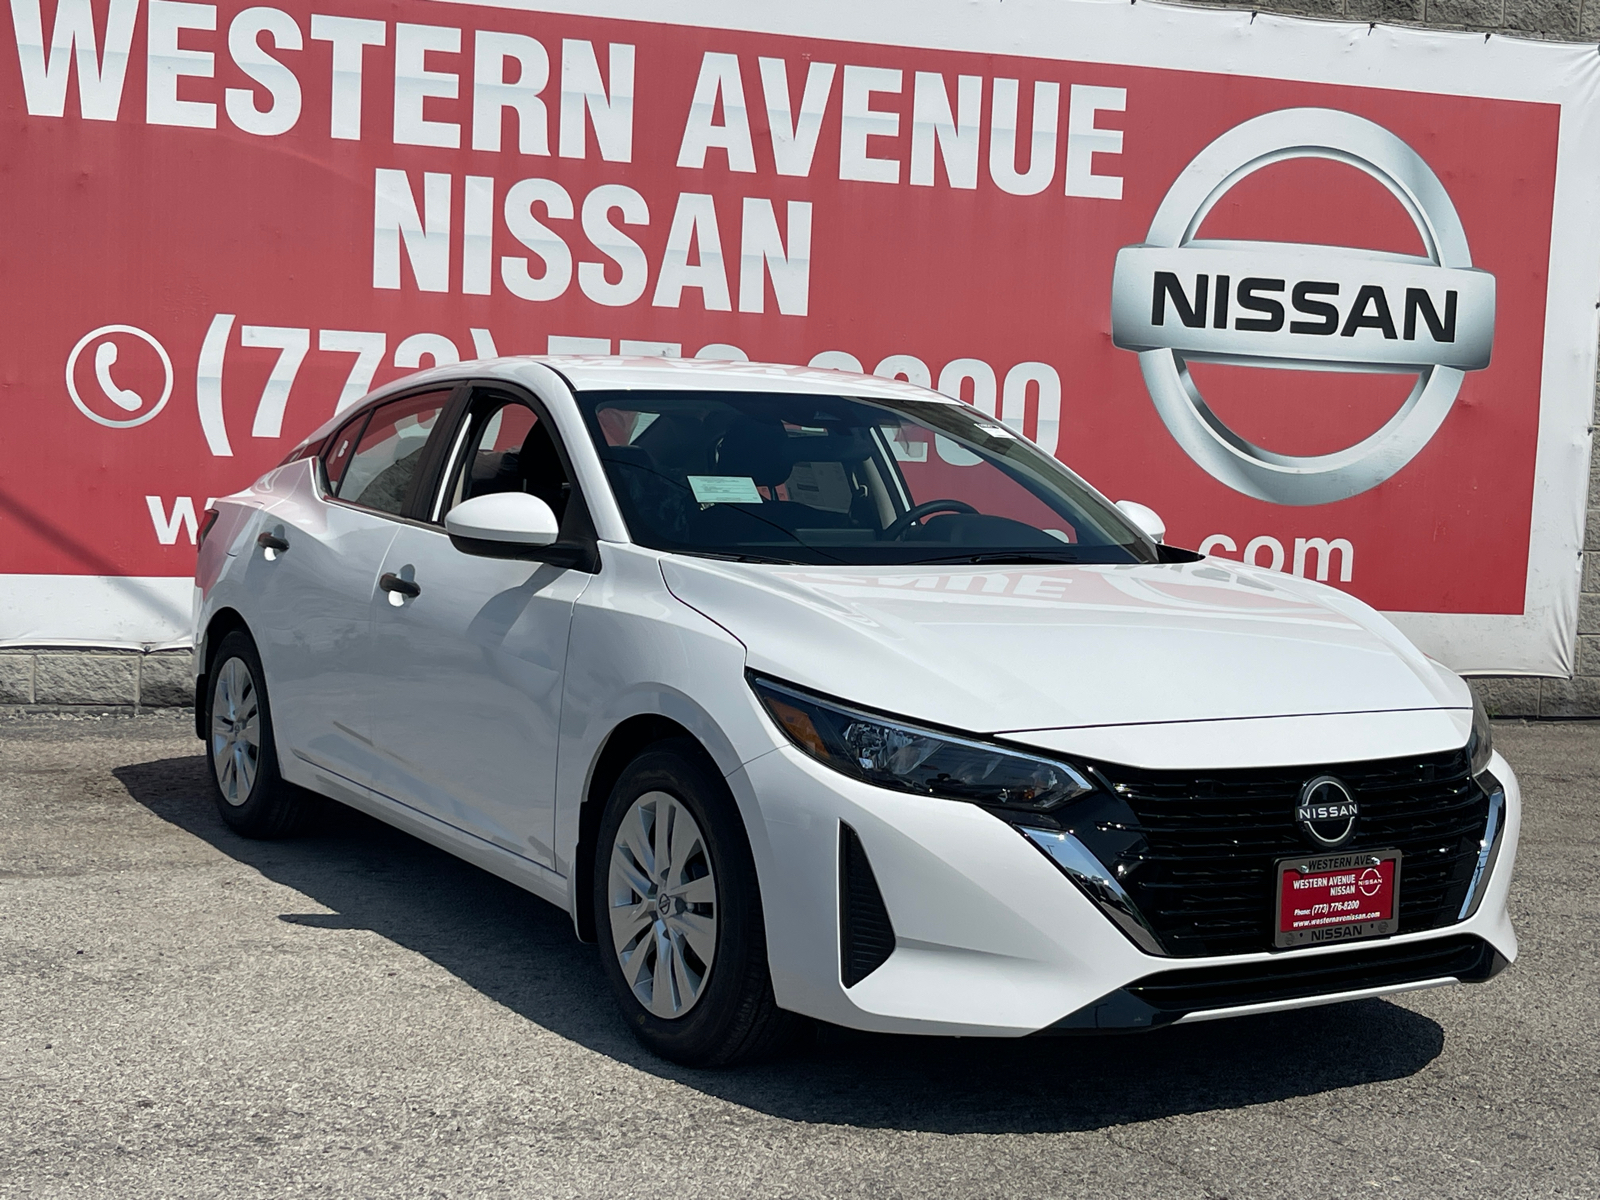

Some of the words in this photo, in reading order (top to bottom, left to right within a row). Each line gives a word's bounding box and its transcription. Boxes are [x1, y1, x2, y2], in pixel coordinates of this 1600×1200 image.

[10, 0, 637, 163] WESTERN
[676, 52, 1128, 201] AVENUE
[372, 167, 813, 317] NISSAN
[1150, 270, 1458, 344] NISSAN
[1299, 804, 1358, 820] NISSAN
[1309, 857, 1351, 871] WESTERN
[1293, 879, 1327, 890] WESTERN
[1328, 874, 1356, 888] AVENUE
[1330, 885, 1356, 896] NISSAN
[1312, 903, 1329, 916] (773)
[1311, 925, 1363, 941] NISSAN
